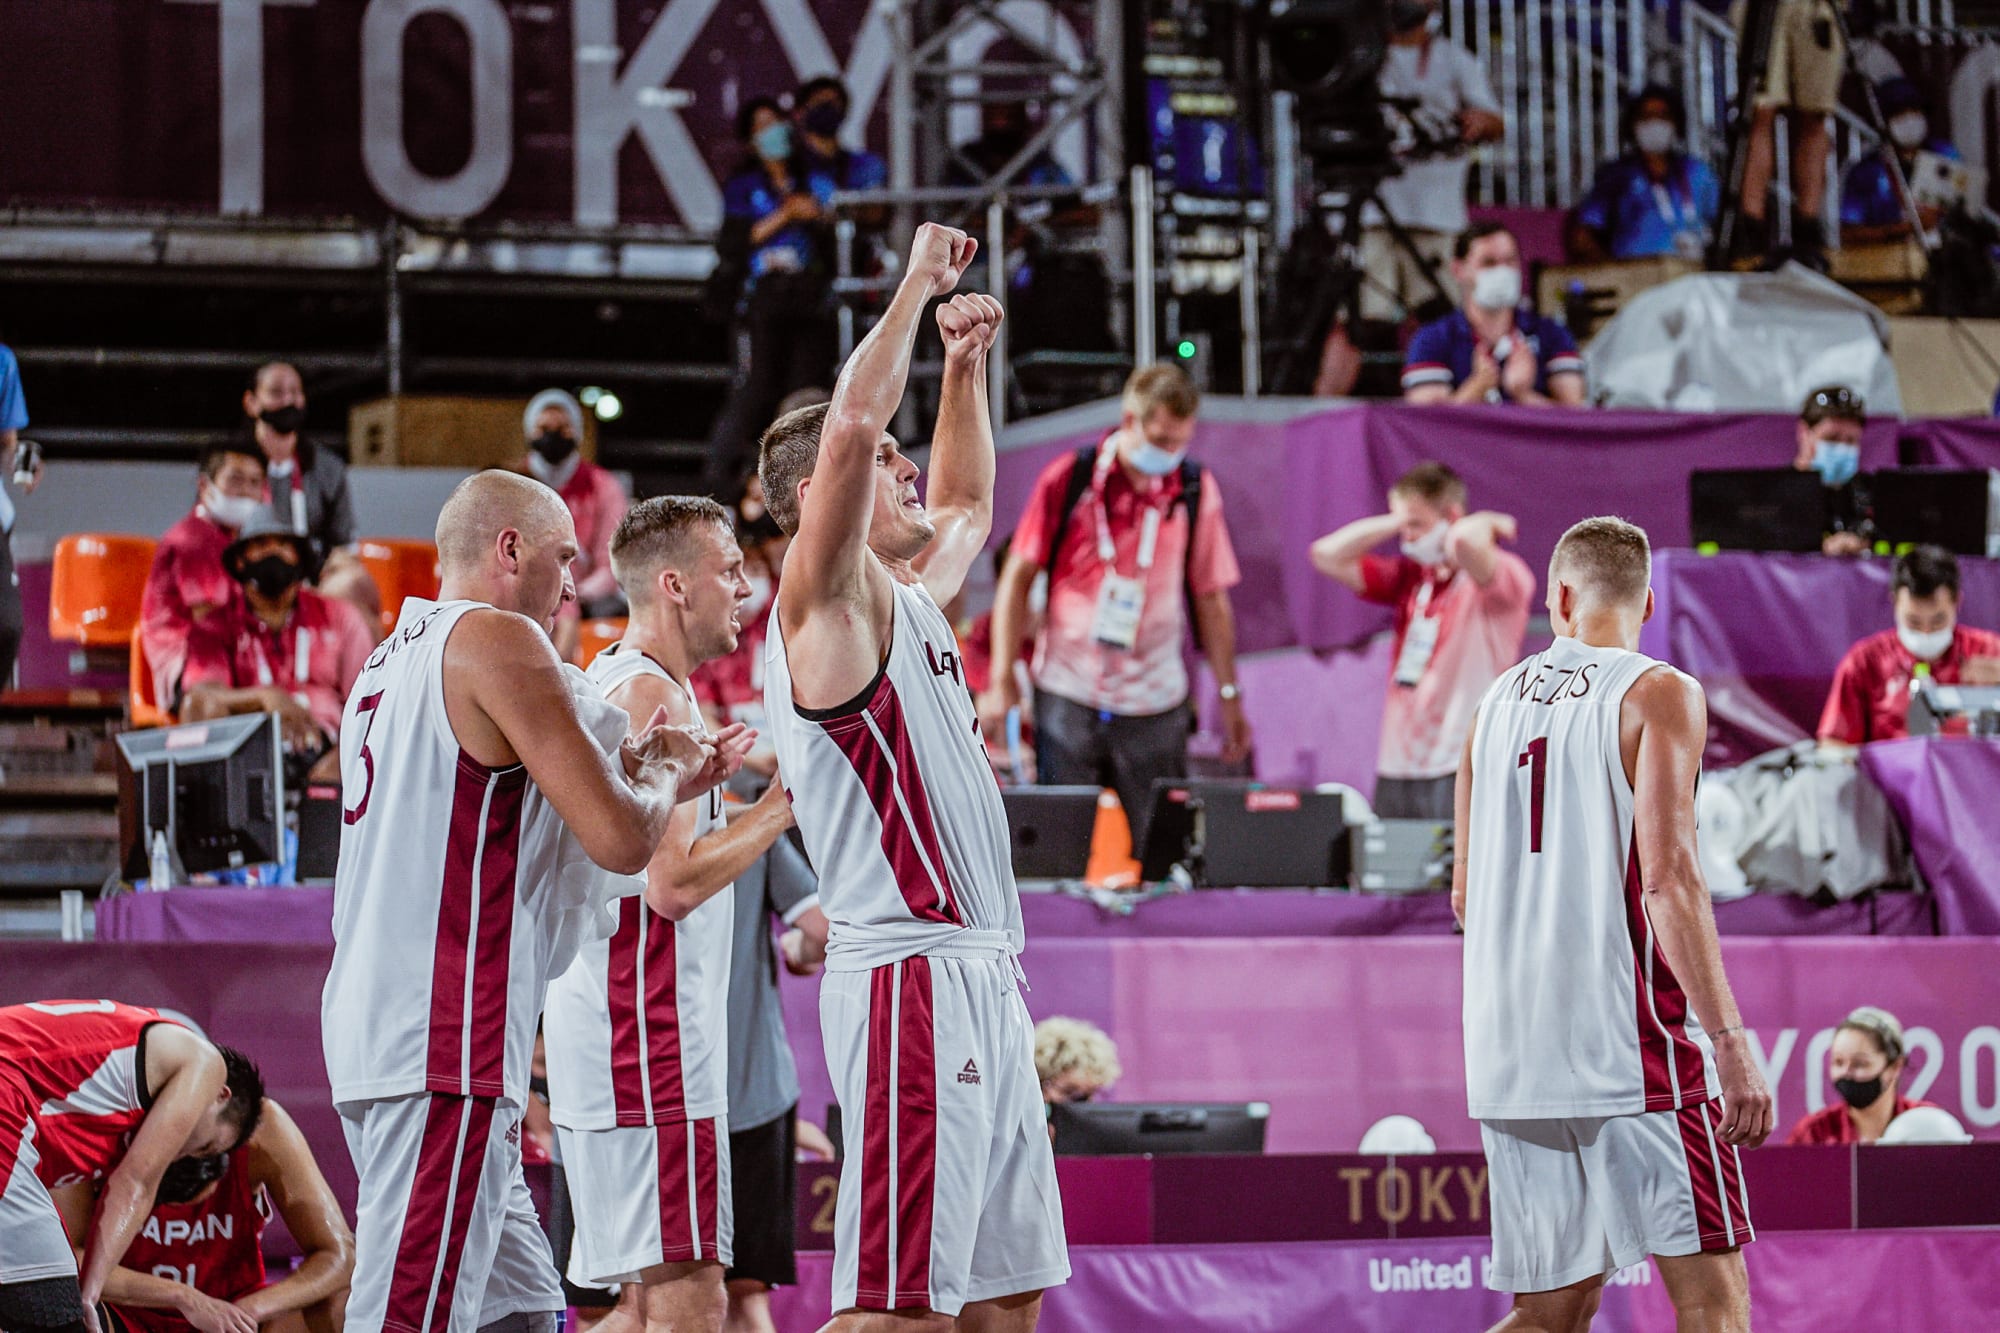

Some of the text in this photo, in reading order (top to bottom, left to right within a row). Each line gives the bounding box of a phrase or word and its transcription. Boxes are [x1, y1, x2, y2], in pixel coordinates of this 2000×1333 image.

[343, 688, 385, 826] 3
[1518, 736, 1548, 853] 1
[957, 1072, 981, 1086] PEAK
[1338, 1166, 1489, 1223] TOKY
[142, 1213, 233, 1247] APAN
[1369, 1255, 1472, 1292] United
